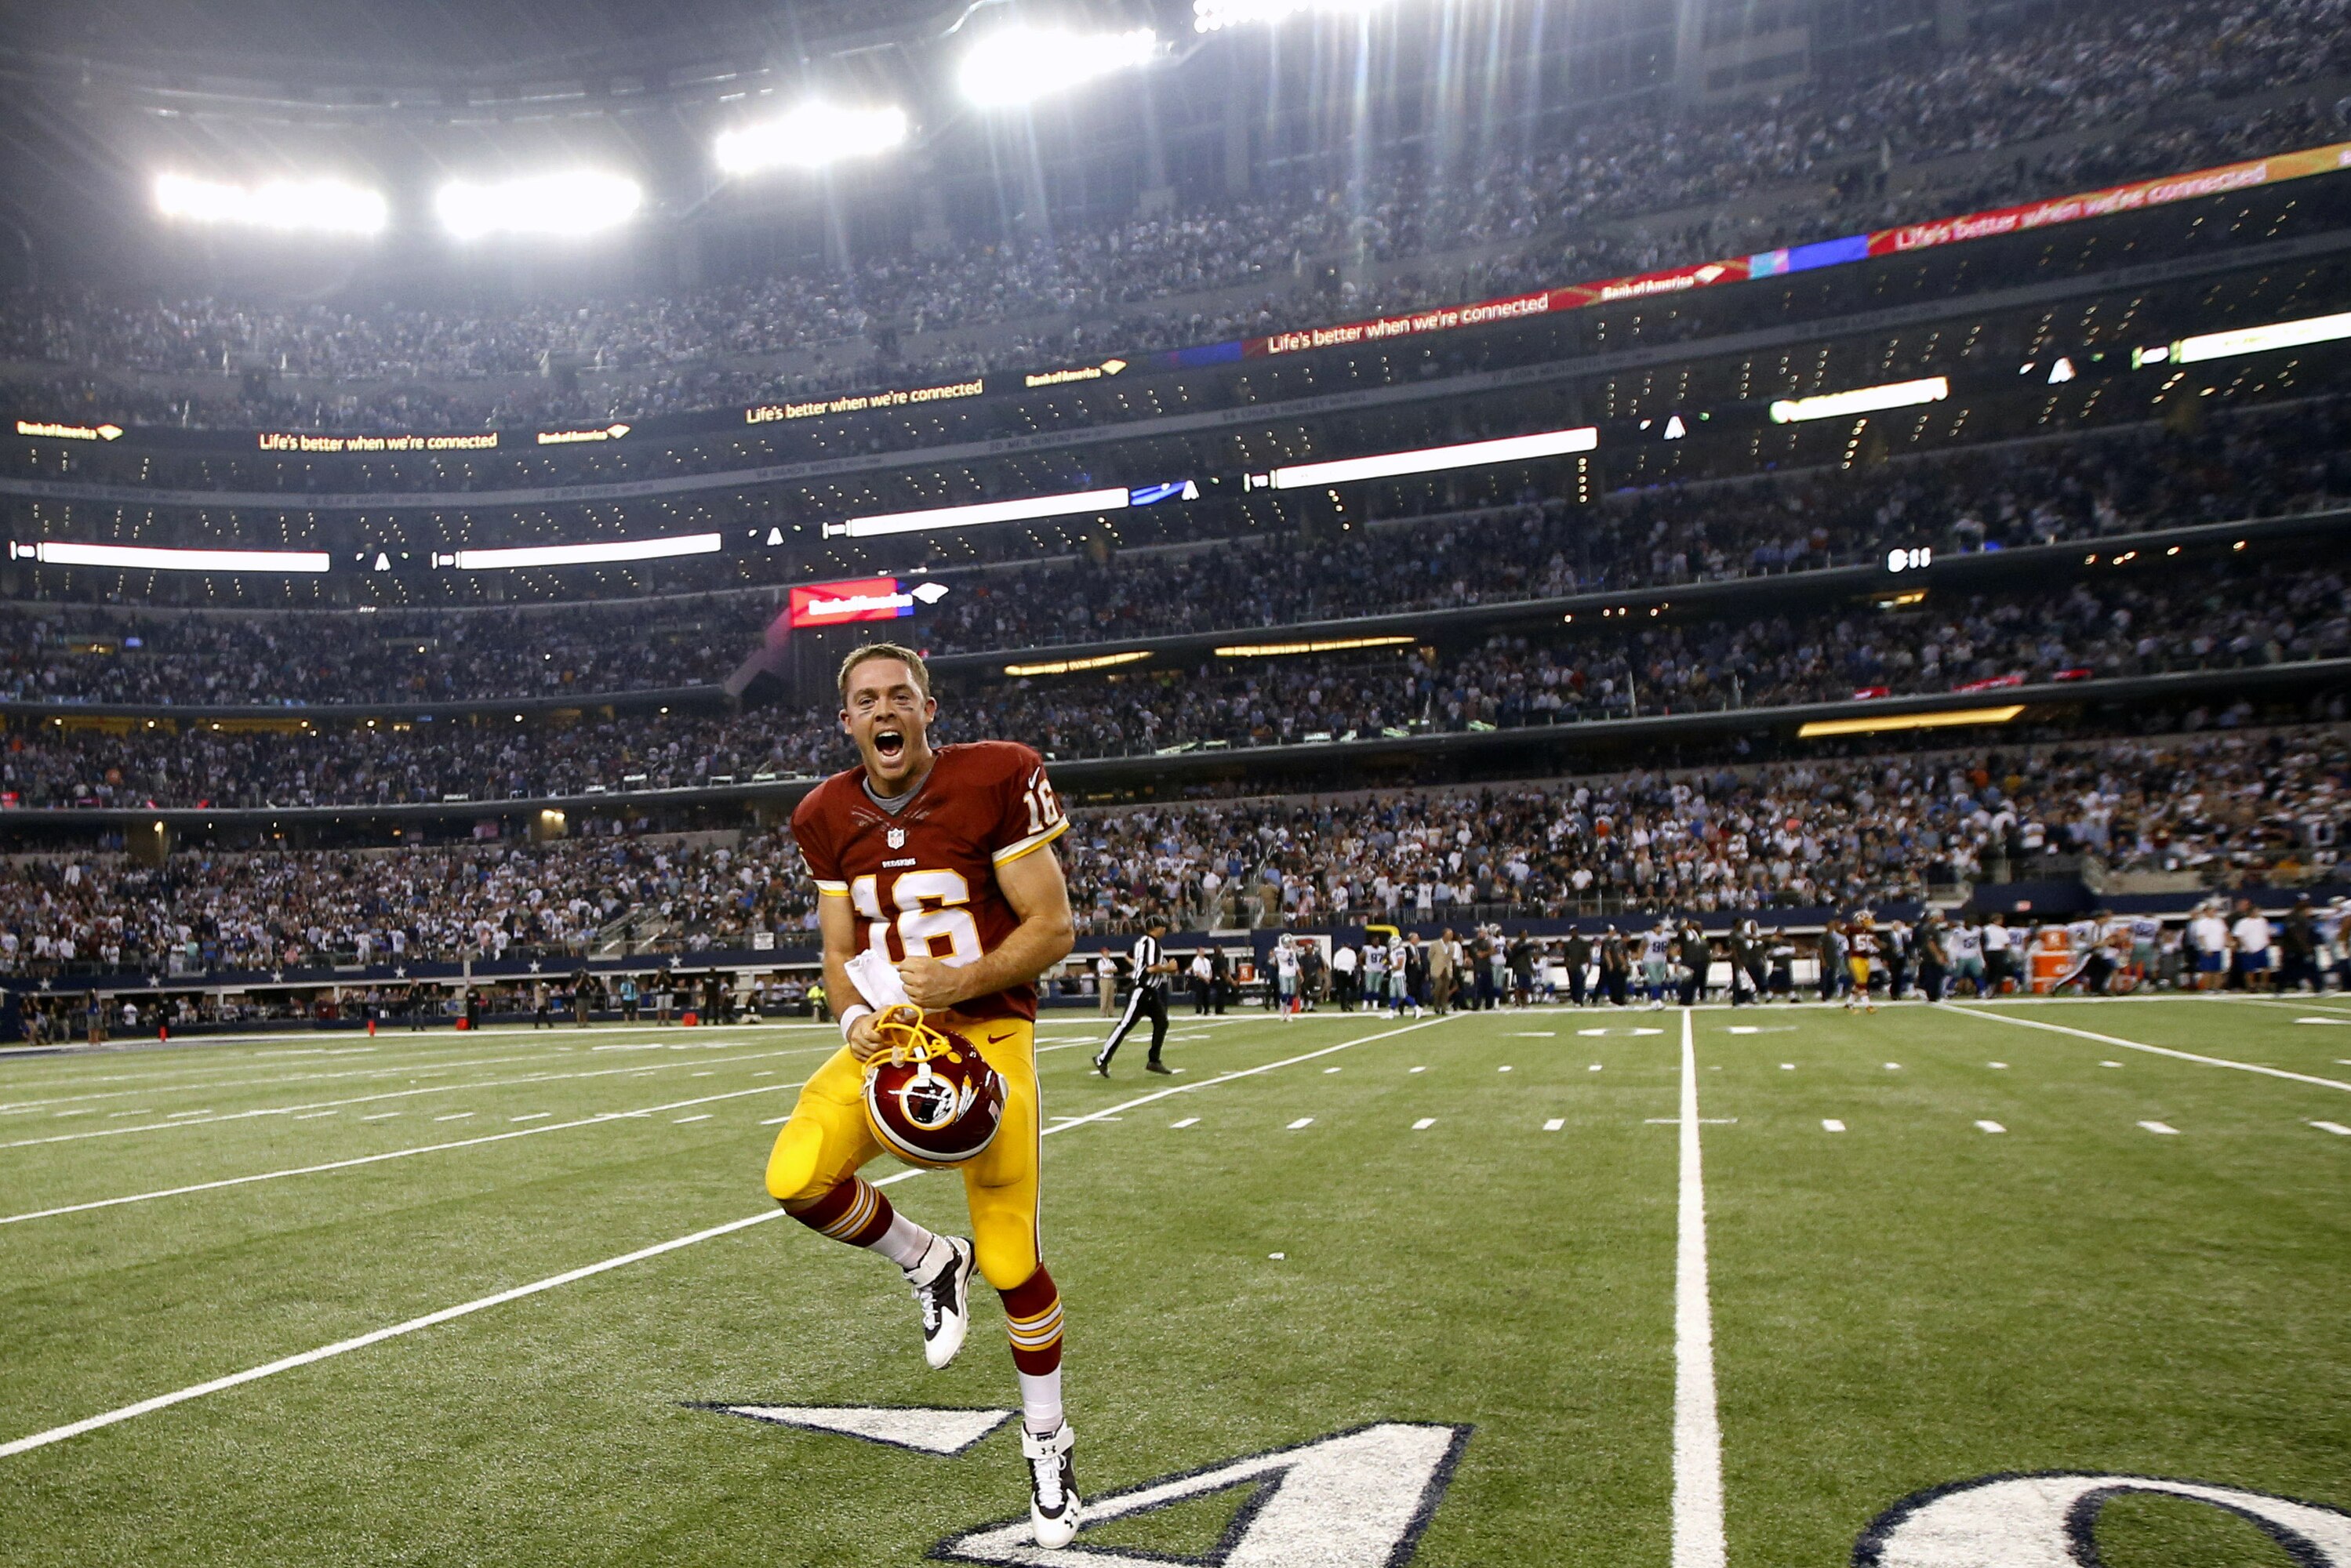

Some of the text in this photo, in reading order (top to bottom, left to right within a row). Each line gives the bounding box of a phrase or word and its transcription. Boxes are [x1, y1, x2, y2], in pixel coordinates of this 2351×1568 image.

[1267, 293, 1549, 354] Life's better when we're connected
[746, 379, 983, 424] Life's better when we're connected
[260, 432, 498, 452] Life's better when we're connected
[1023, 778, 1059, 836] 16
[850, 868, 984, 968] 16
